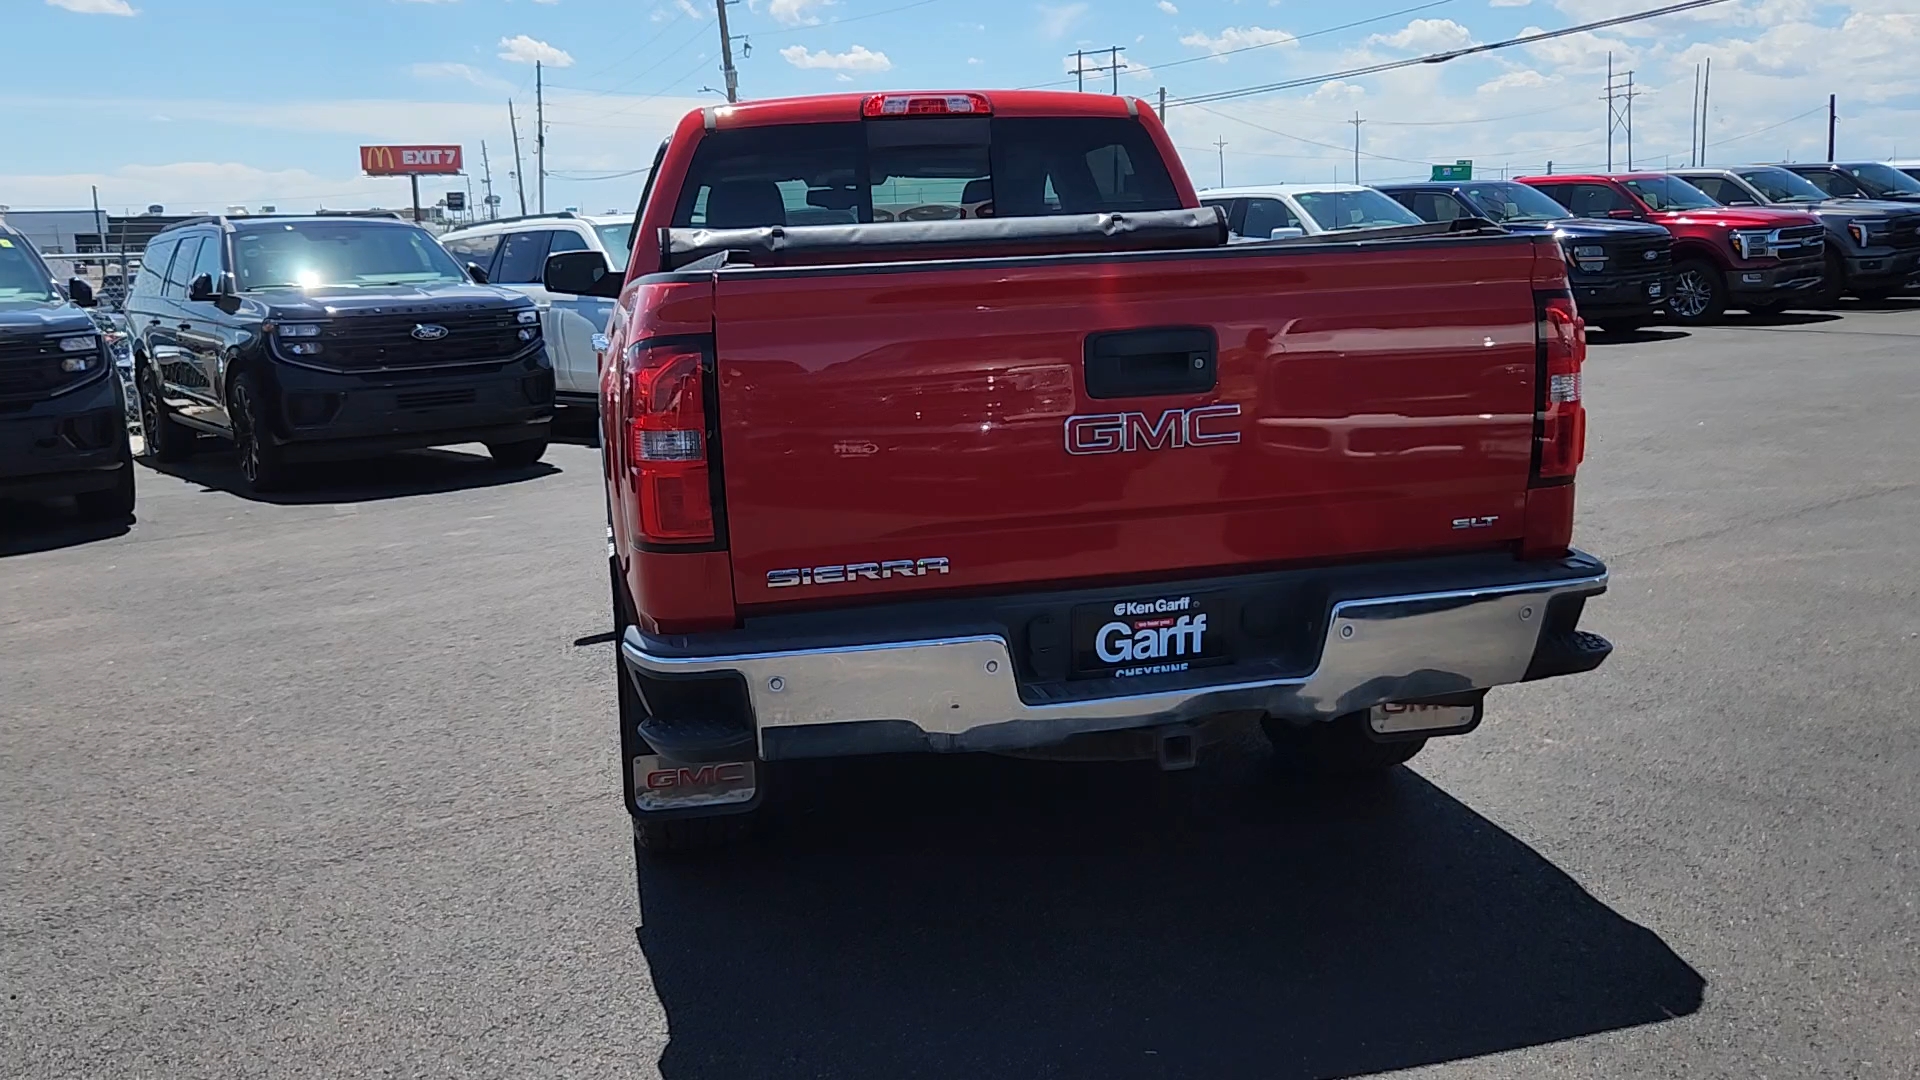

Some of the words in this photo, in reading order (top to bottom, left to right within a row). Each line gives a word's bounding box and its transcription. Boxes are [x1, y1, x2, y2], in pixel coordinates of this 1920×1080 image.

[402, 150, 442, 165] EXIT
[445, 150, 456, 165] 7
[1064, 404, 1241, 455] GMC
[1452, 515, 1499, 529] SLT
[766, 556, 949, 588] SIERRA
[1126, 601, 1154, 616] Ken
[1155, 596, 1190, 613] Garff
[1095, 613, 1207, 663] Garff
[646, 762, 745, 790] GMC
